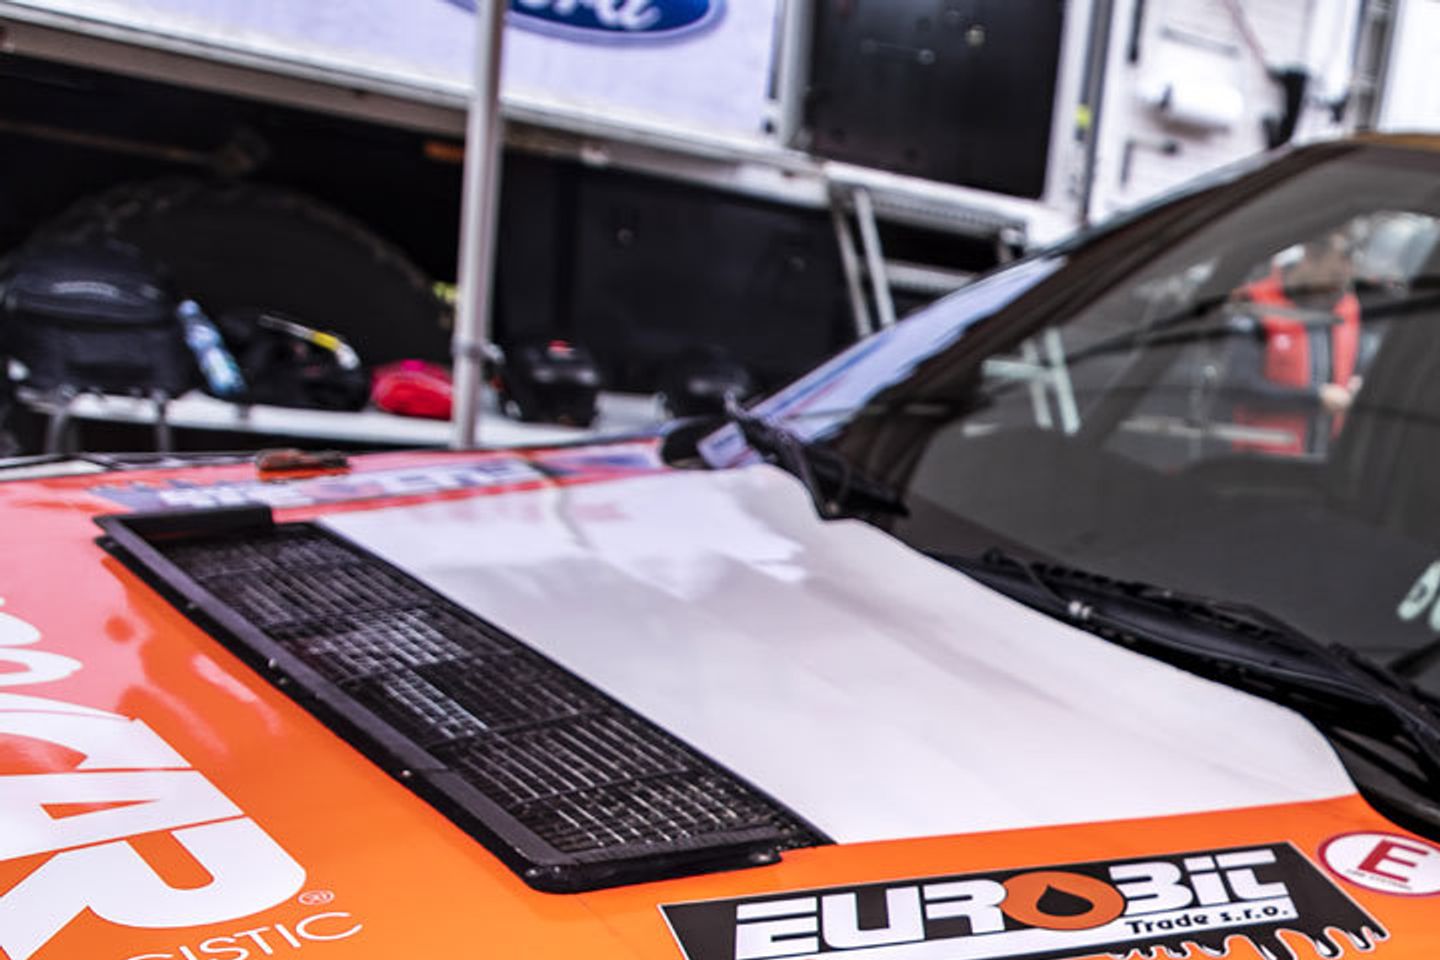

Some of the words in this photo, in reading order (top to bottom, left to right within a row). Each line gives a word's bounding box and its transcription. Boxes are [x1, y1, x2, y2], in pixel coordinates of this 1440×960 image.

[1358, 839, 1429, 883] E
[1130, 914, 1208, 934] Trade
[1219, 905, 1288, 922] s.r.o.
